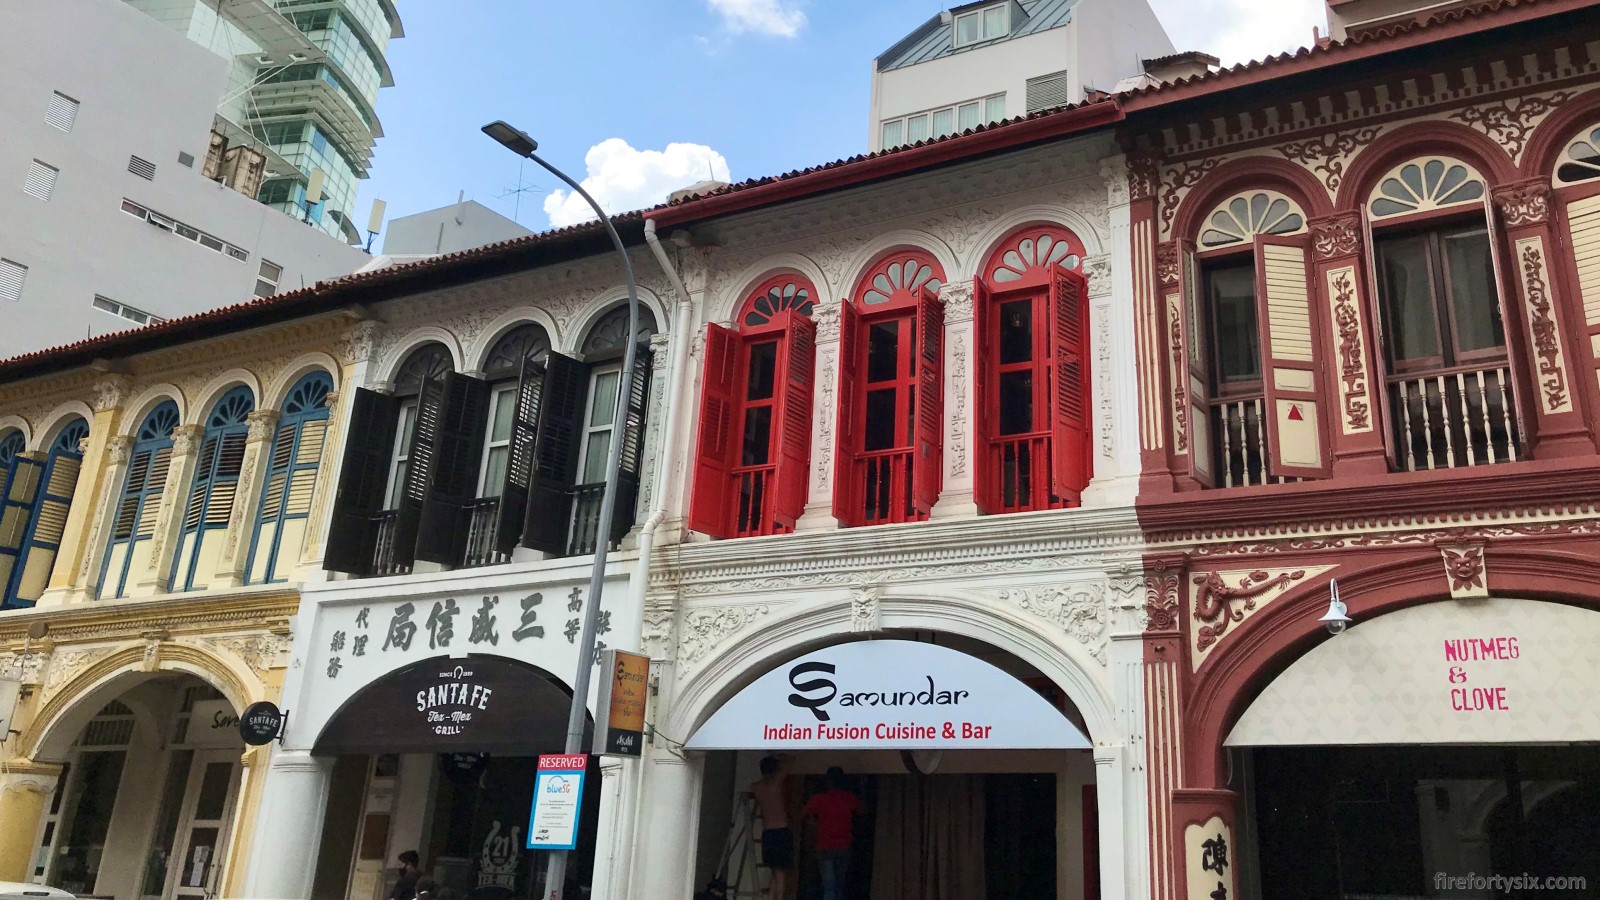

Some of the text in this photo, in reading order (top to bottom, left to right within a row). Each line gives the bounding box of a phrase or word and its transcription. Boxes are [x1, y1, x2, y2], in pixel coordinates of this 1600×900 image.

[1444, 637, 1520, 662] NUTMEG
[1448, 665, 1468, 684] &
[416, 683, 493, 712] SANTA FE
[788, 661, 969, 722] Samundar
[1450, 687, 1509, 711] CLOVE
[249, 716, 279, 728] SANTA FE
[434, 725, 461, 735] GRILL
[763, 721, 992, 740] Indian Fusion Cuisine & Bar
[539, 757, 585, 768] RESERVED
[491, 835, 510, 857] 21
